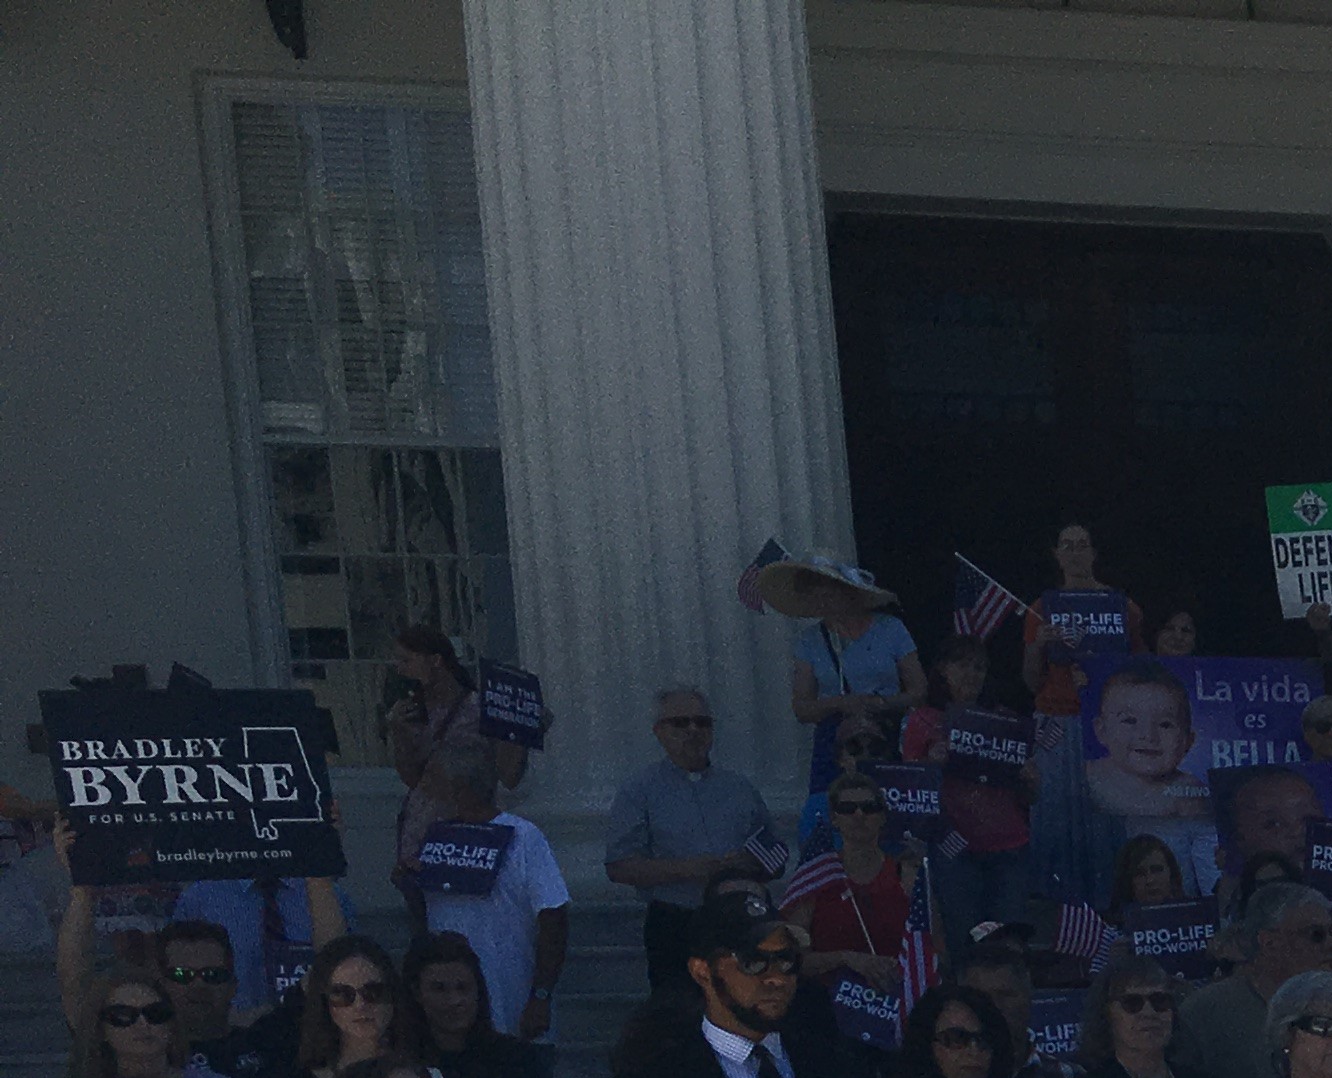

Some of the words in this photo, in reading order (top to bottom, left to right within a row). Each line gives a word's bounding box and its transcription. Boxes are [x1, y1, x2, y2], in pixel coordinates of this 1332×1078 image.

[1195, 670, 1233, 702] La
[1241, 674, 1311, 703] vida
[485, 690, 541, 716] PRO-LIFE
[1243, 713, 1267, 729] es
[58, 738, 227, 761] BRADLEY
[950, 729, 1028, 754] PRO-LIFE
[950, 742, 1027, 765] PRO-WOMAN
[62, 763, 299, 807] BYRNE
[881, 787, 940, 804] O-LIFE
[89, 813, 125, 825] FOR
[133, 812, 163, 824] U.S.
[169, 810, 236, 822] SENATE
[887, 801, 941, 815] -WOMAN
[156, 848, 293, 864] bradleybyrne.com
[423, 842, 499, 860] PRO-LIFE
[419, 854, 496, 871] PRO-WOMAN
[1133, 924, 1215, 945] PRO-LIFE
[1135, 940, 1208, 956] PRO-WOMA
[835, 992, 899, 1021] PRO-WOM
[840, 981, 901, 1011] PRO-LI
